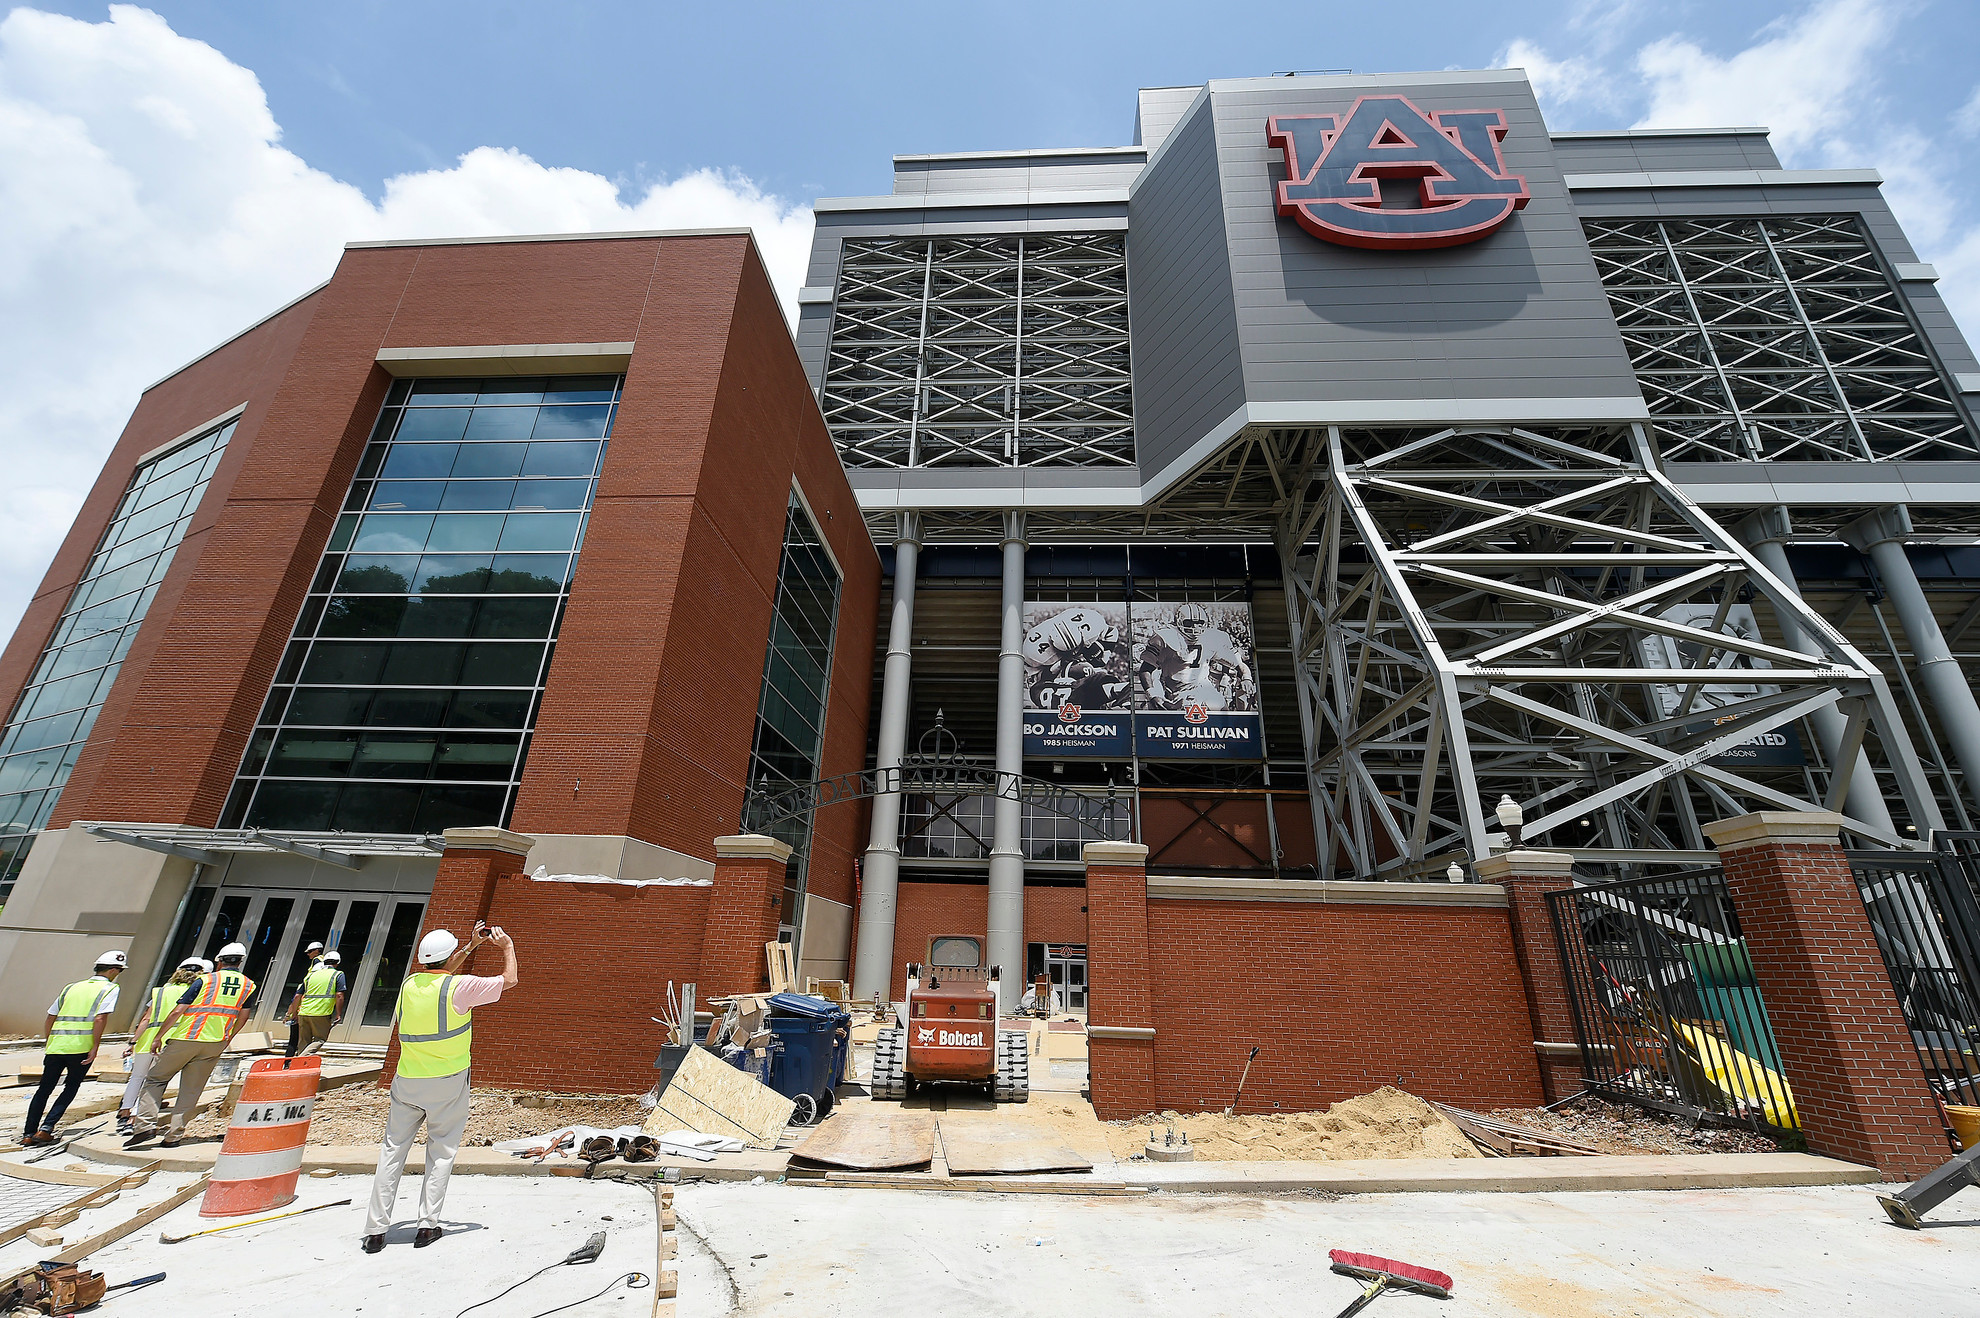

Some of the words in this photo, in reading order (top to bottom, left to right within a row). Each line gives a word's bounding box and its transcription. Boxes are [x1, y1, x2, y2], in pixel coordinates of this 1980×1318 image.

[1023, 724, 1045, 735] BO
[1048, 724, 1117, 736] JACKSON
[1147, 726, 1173, 738] PAT
[1177, 727, 1249, 739] SULLIVAN
[1043, 739, 1061, 747] 1985
[1172, 742, 1189, 750] 1971
[766, 770, 879, 825] JORDAN
[974, 768, 1111, 829] STADIUM
[939, 1030, 984, 1047] Bobcat
